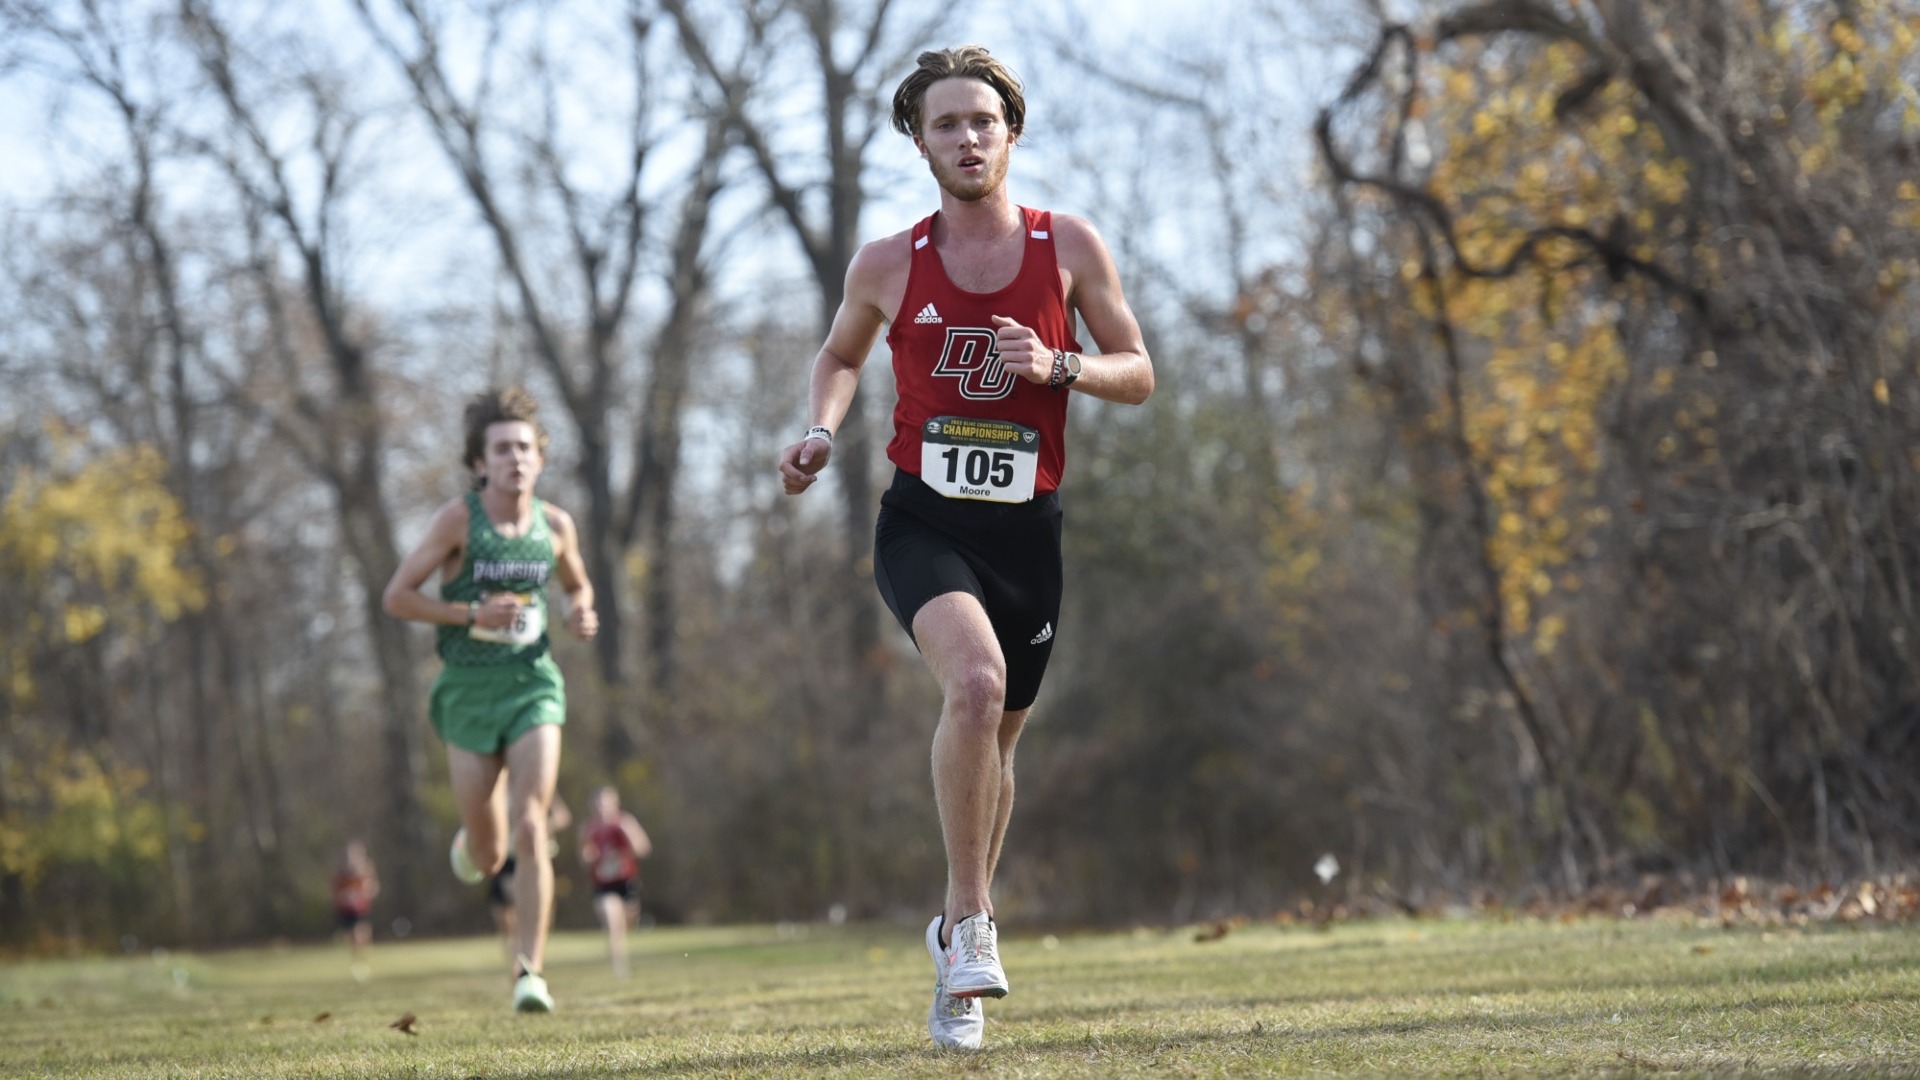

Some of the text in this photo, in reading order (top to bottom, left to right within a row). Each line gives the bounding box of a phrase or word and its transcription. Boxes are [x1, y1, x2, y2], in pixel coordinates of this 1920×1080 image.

[914, 315, 942, 324] adidas
[931, 327, 1016, 399] DU
[943, 424, 1019, 442] CHAMPIONSHIPS
[942, 447, 1015, 488] 105
[960, 486, 991, 497] Moore
